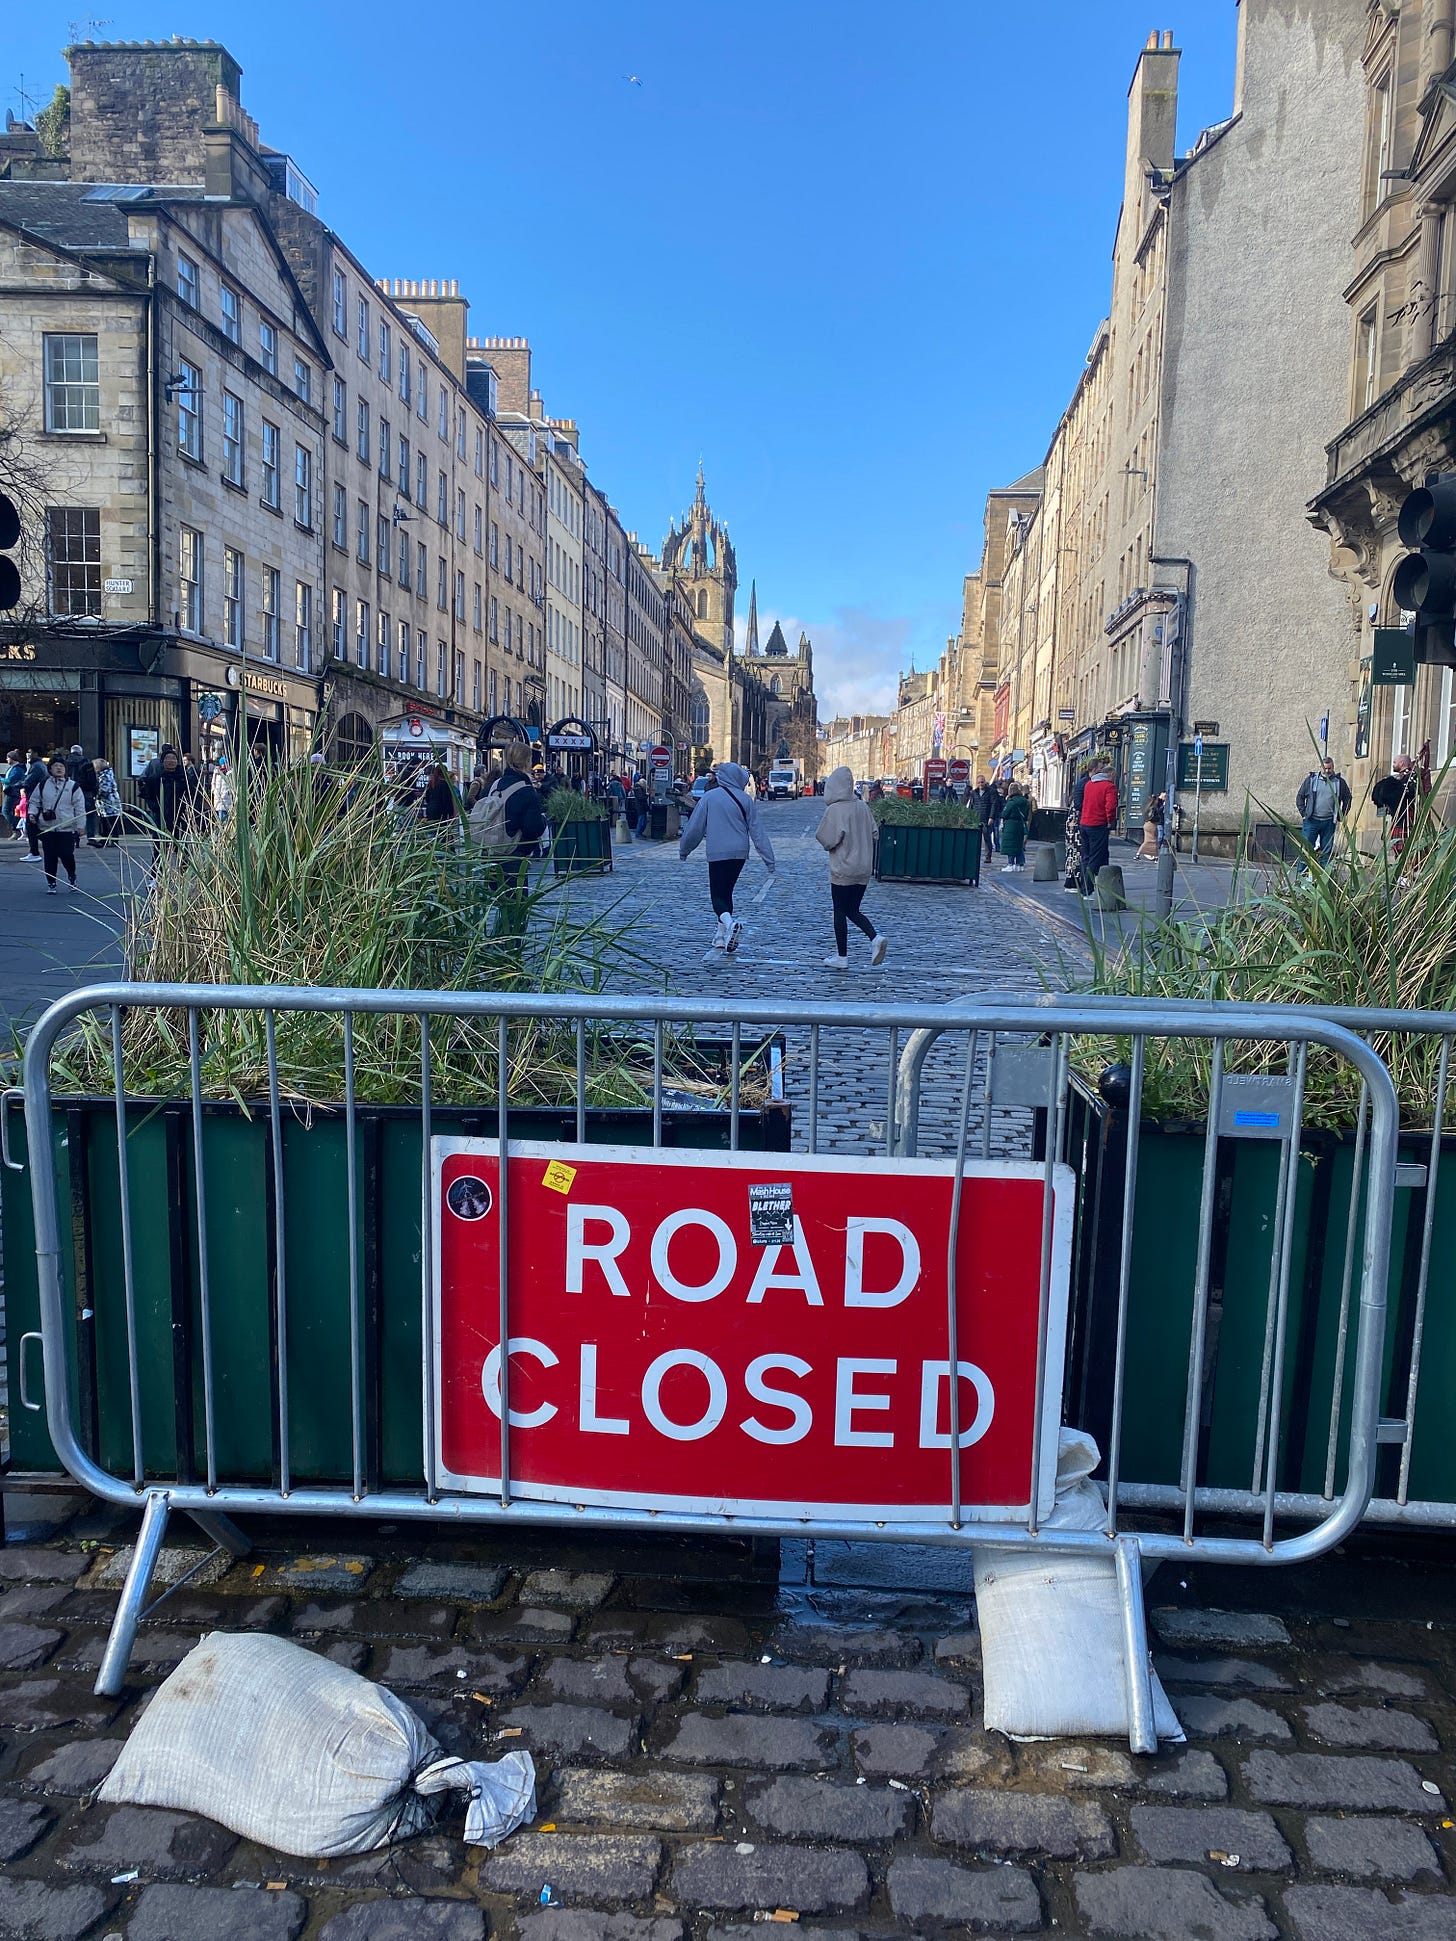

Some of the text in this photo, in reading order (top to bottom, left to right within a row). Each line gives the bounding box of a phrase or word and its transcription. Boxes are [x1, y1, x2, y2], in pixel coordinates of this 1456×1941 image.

[752, 1200, 791, 1211] BLETHER
[769, 1186, 791, 1195] House
[565, 1202, 922, 1309] ROAD
[481, 1336, 995, 1450] CLOSED
